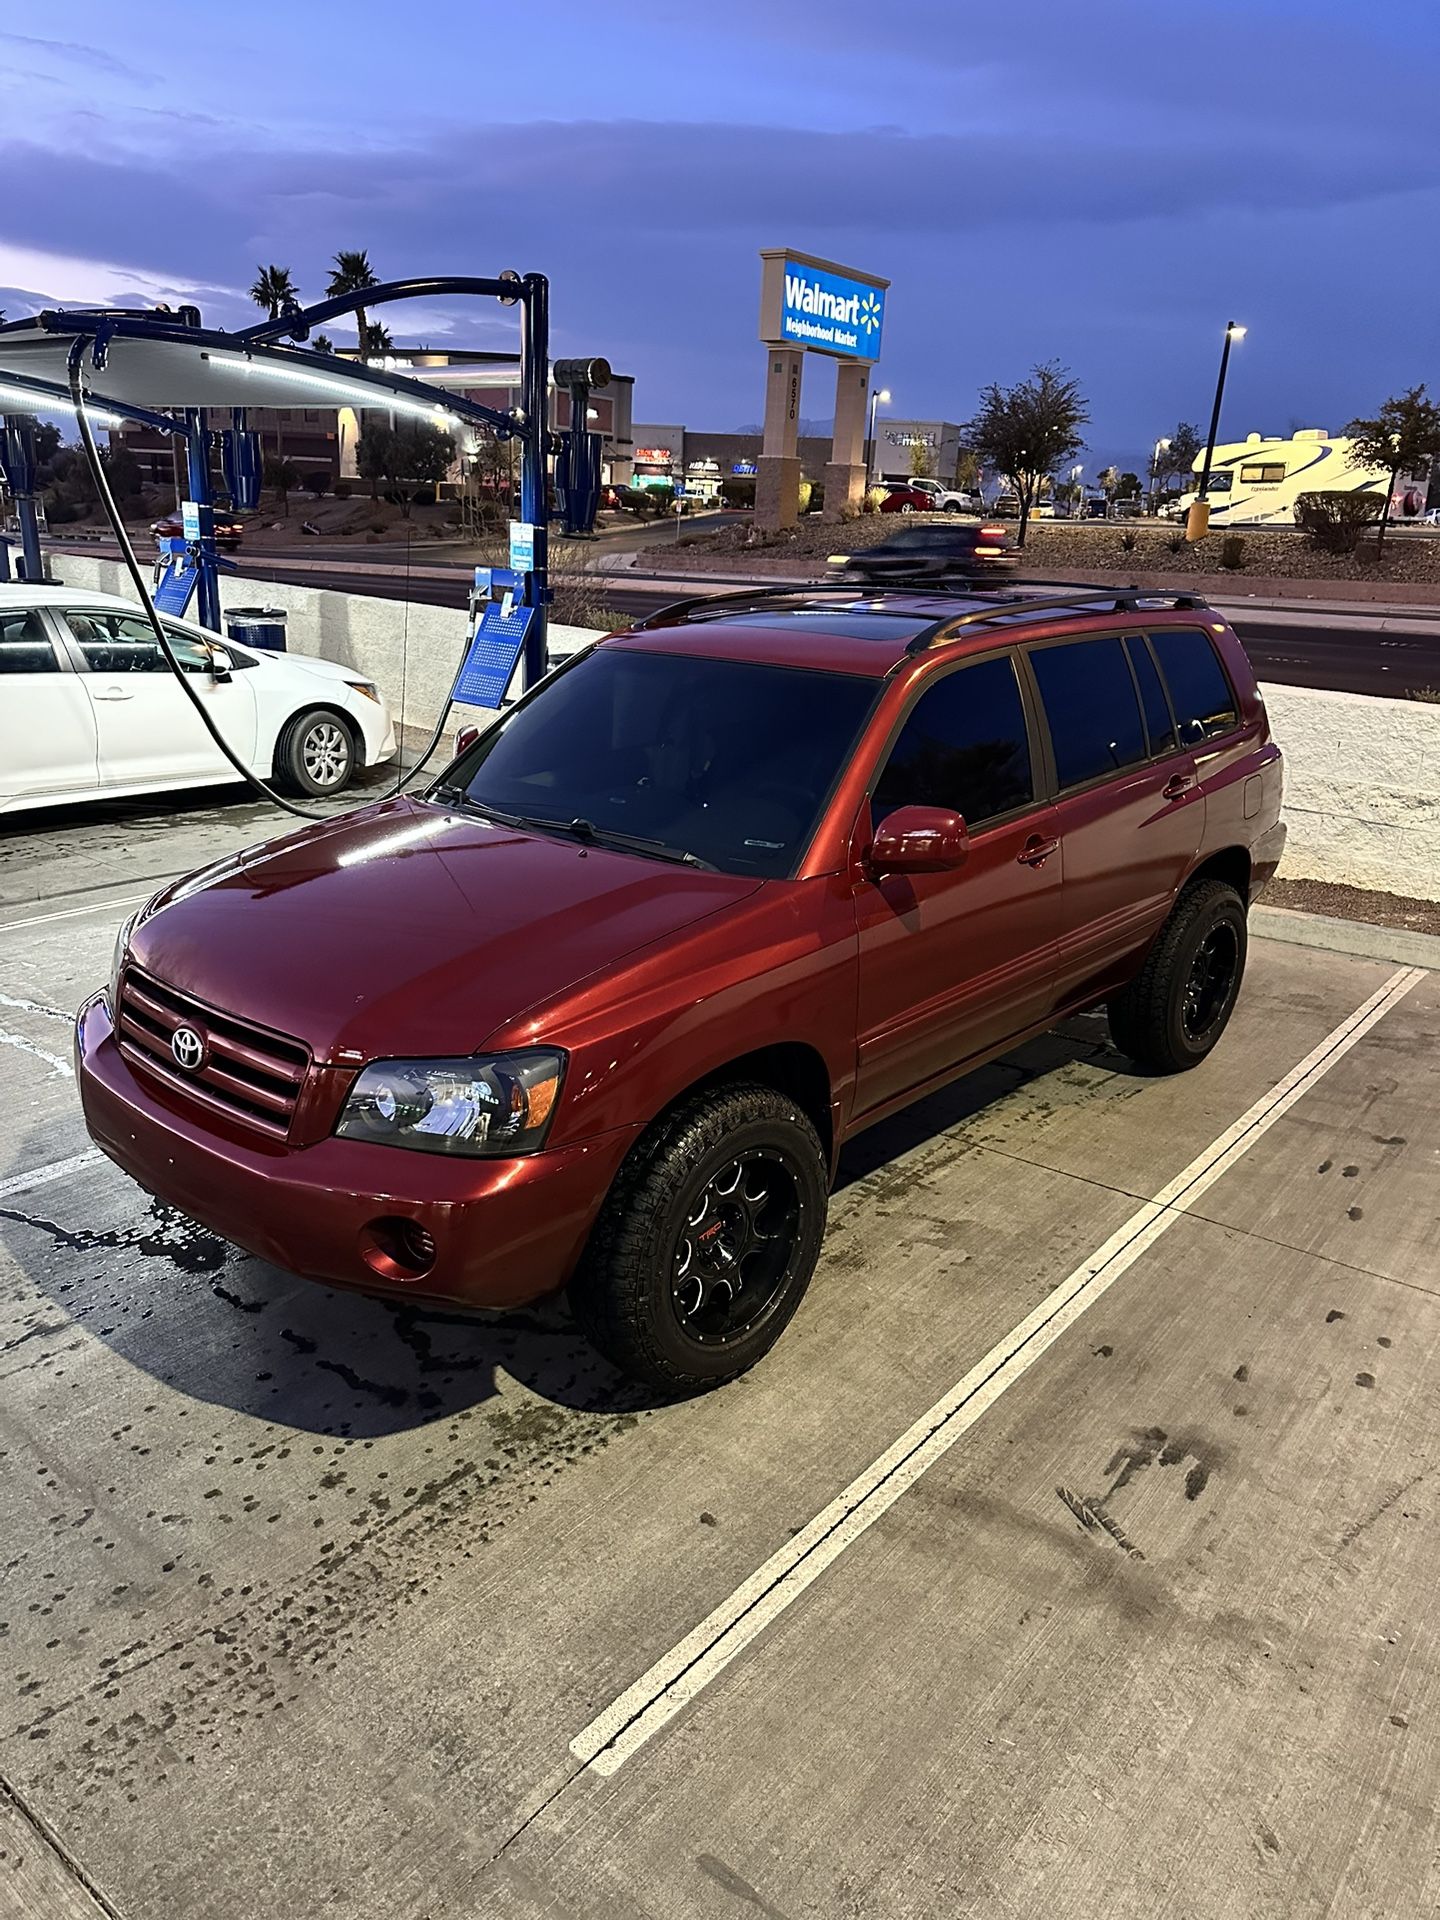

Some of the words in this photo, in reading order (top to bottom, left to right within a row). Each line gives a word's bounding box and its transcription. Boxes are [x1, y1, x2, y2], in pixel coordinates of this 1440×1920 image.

[785, 274, 860, 326] Walmart
[786, 316, 834, 343] Neighborhood
[834, 328, 858, 347] Market
[789, 377, 797, 420] 6570
[699, 1221, 722, 1241] TRD
